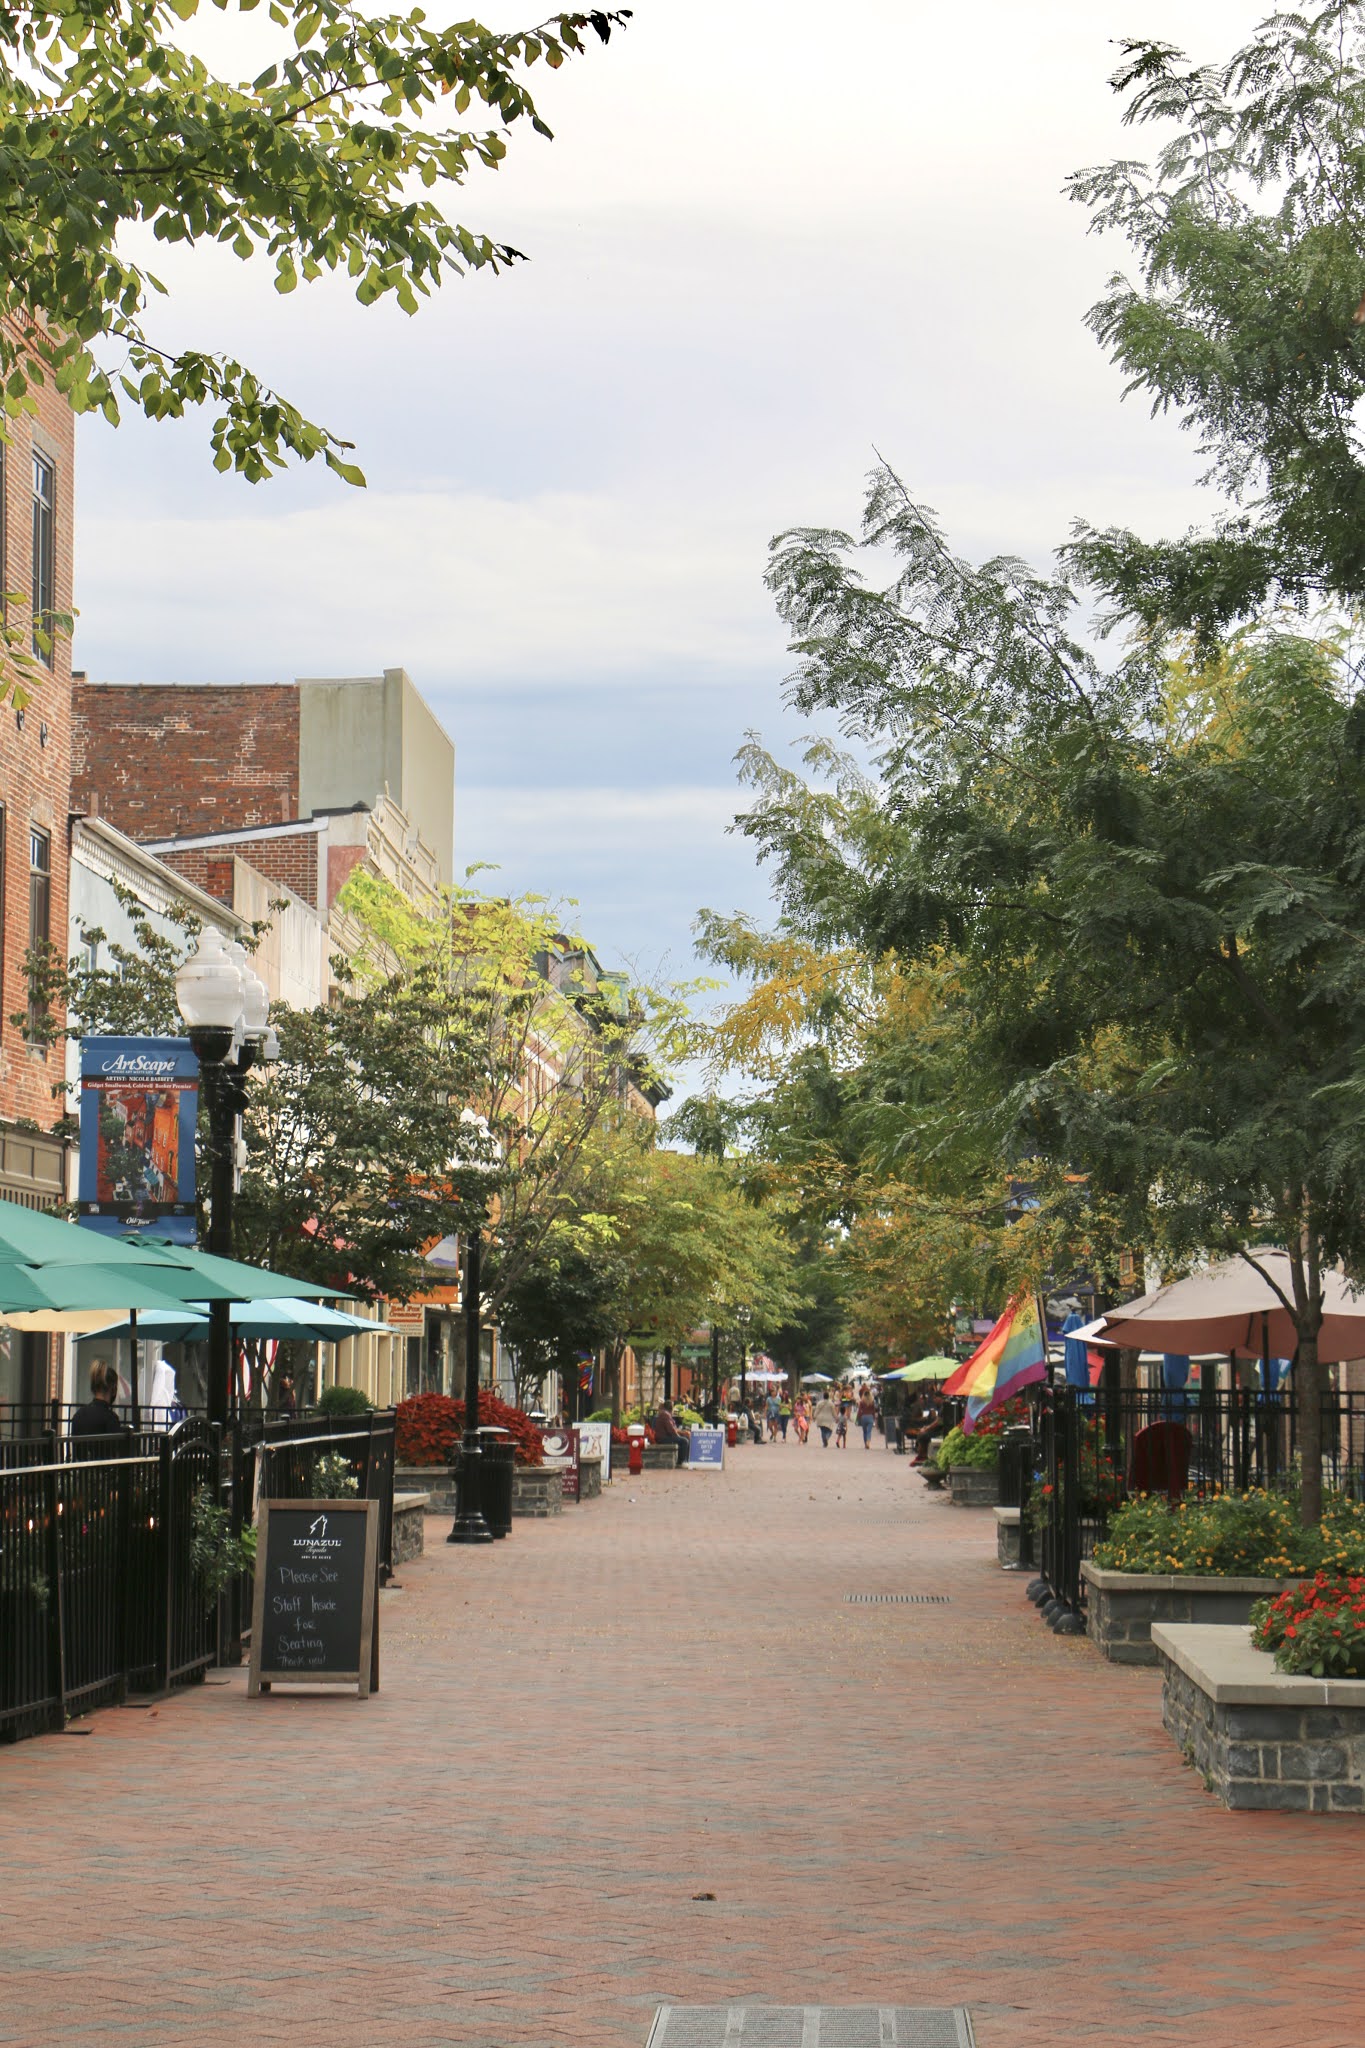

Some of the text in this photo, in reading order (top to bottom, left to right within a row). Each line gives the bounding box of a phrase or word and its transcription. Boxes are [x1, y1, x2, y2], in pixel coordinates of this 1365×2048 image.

[102, 1054, 175, 1075] ArtScape
[293, 1539, 341, 1547] LUNAZUL
[305, 1546, 327, 1554] Tequila
[279, 1567, 339, 1584] Please See
[273, 1595, 337, 1615] Staff Inside
[278, 1634, 324, 1654] Seating
[276, 1654, 305, 1667] Thank
